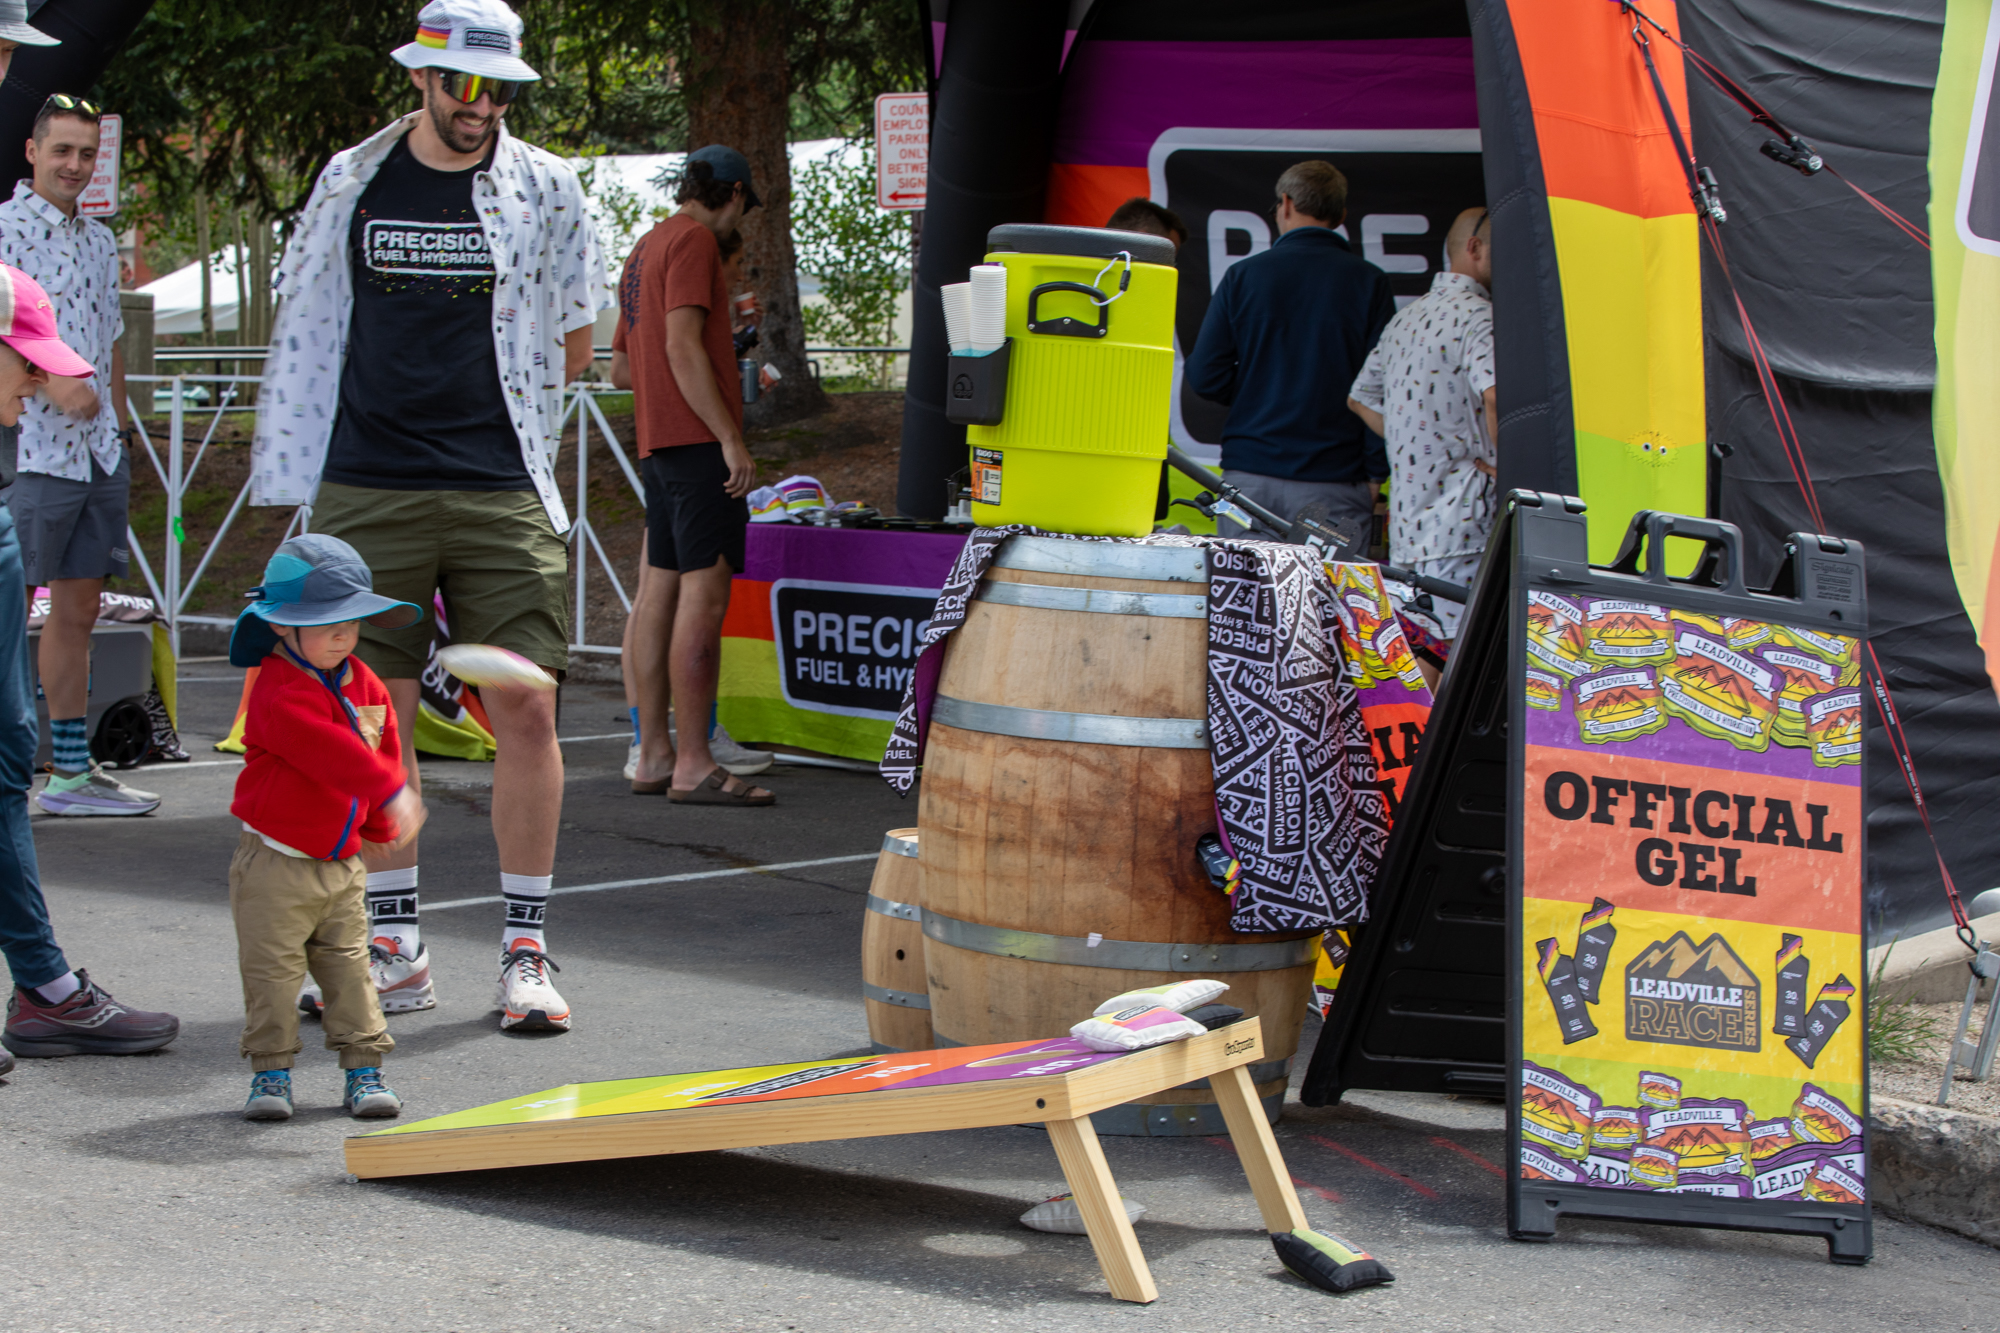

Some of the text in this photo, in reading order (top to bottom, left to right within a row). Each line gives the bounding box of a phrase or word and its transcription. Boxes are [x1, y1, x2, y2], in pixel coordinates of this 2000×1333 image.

[373, 250, 409, 262] FUEL
[409, 251, 421, 263] &
[1601, 602, 1651, 612] LEADVILLE
[796, 657, 851, 686] FUEL
[856, 663, 872, 688] &
[1694, 639, 1761, 678] LEADVILLE
[1774, 653, 1822, 672] LEADVILLE
[1590, 674, 1638, 689] LEADVILLE
[1667, 687, 1698, 711] PRECISION
[1699, 704, 1715, 720] FUEL
[1721, 716, 1756, 735] HYDRATION
[1544, 771, 1843, 853] OFFICIAL
[1636, 837, 1757, 897] GEL
[1629, 977, 1743, 1007] LEADVILLE
[1629, 997, 1744, 1046] RACE
[1743, 989, 1757, 1046] SERIES
[1528, 1072, 1581, 1102] LEADVILLE
[1663, 1110, 1723, 1123] LEADVILLE
[1817, 1097, 1855, 1128] LEADVILLE
